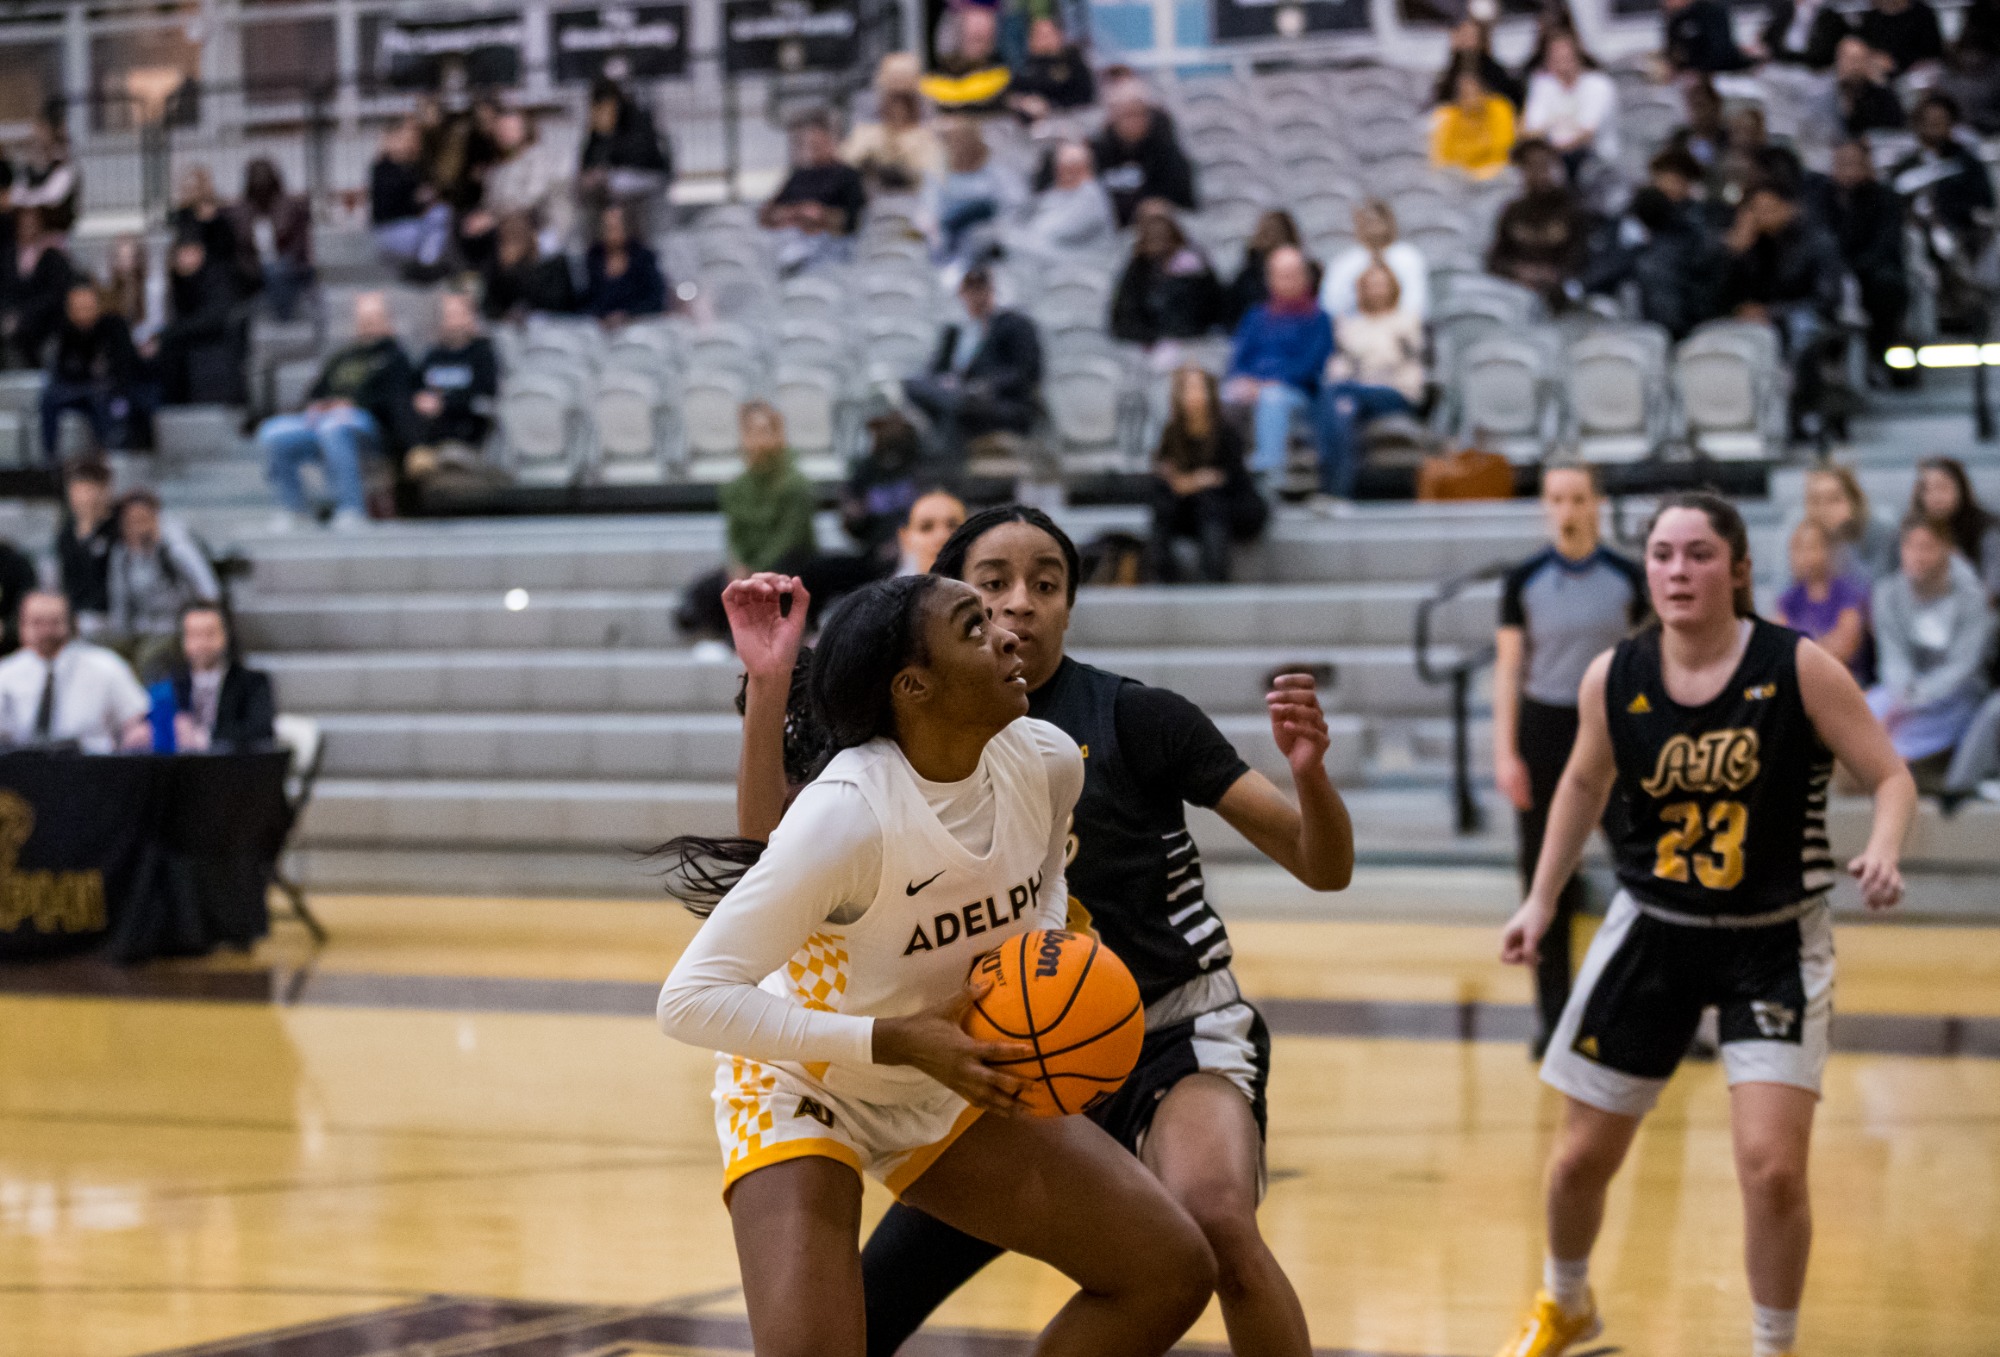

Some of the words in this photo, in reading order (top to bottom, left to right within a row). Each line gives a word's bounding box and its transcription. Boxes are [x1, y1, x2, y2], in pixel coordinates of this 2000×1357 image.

[1640, 727, 1761, 799] AIC
[1653, 800, 1749, 891] 23
[902, 868, 1043, 956] ADELPH
[1035, 929, 1077, 979] lson
